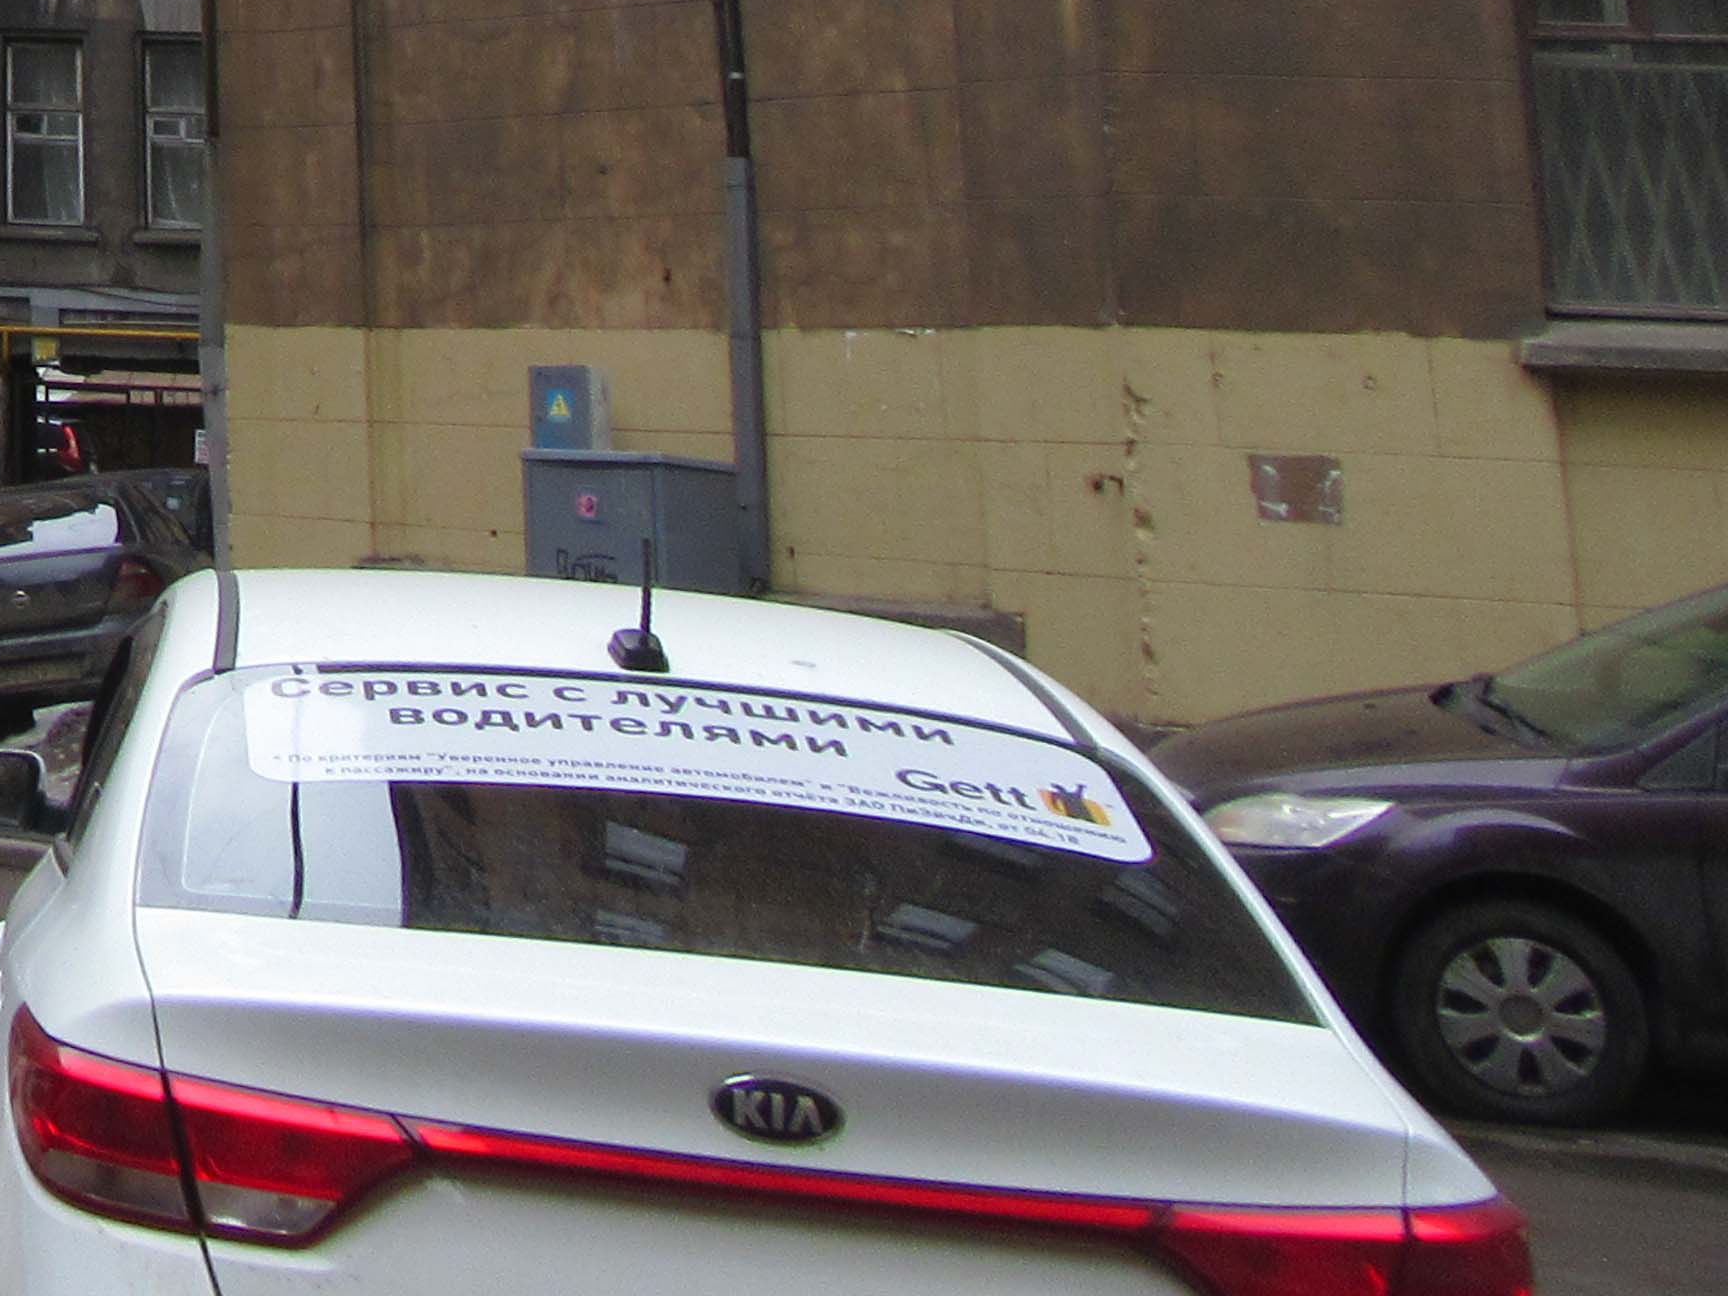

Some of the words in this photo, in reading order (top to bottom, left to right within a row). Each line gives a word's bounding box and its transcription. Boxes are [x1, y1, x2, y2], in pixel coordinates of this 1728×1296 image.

[271, 677, 529, 701] Сервис
[553, 686, 587, 702] с
[610, 689, 955, 746] лучшими
[388, 707, 848, 758] водителями
[896, 768, 1038, 810] Gett
[733, 1088, 823, 1136] KIA
